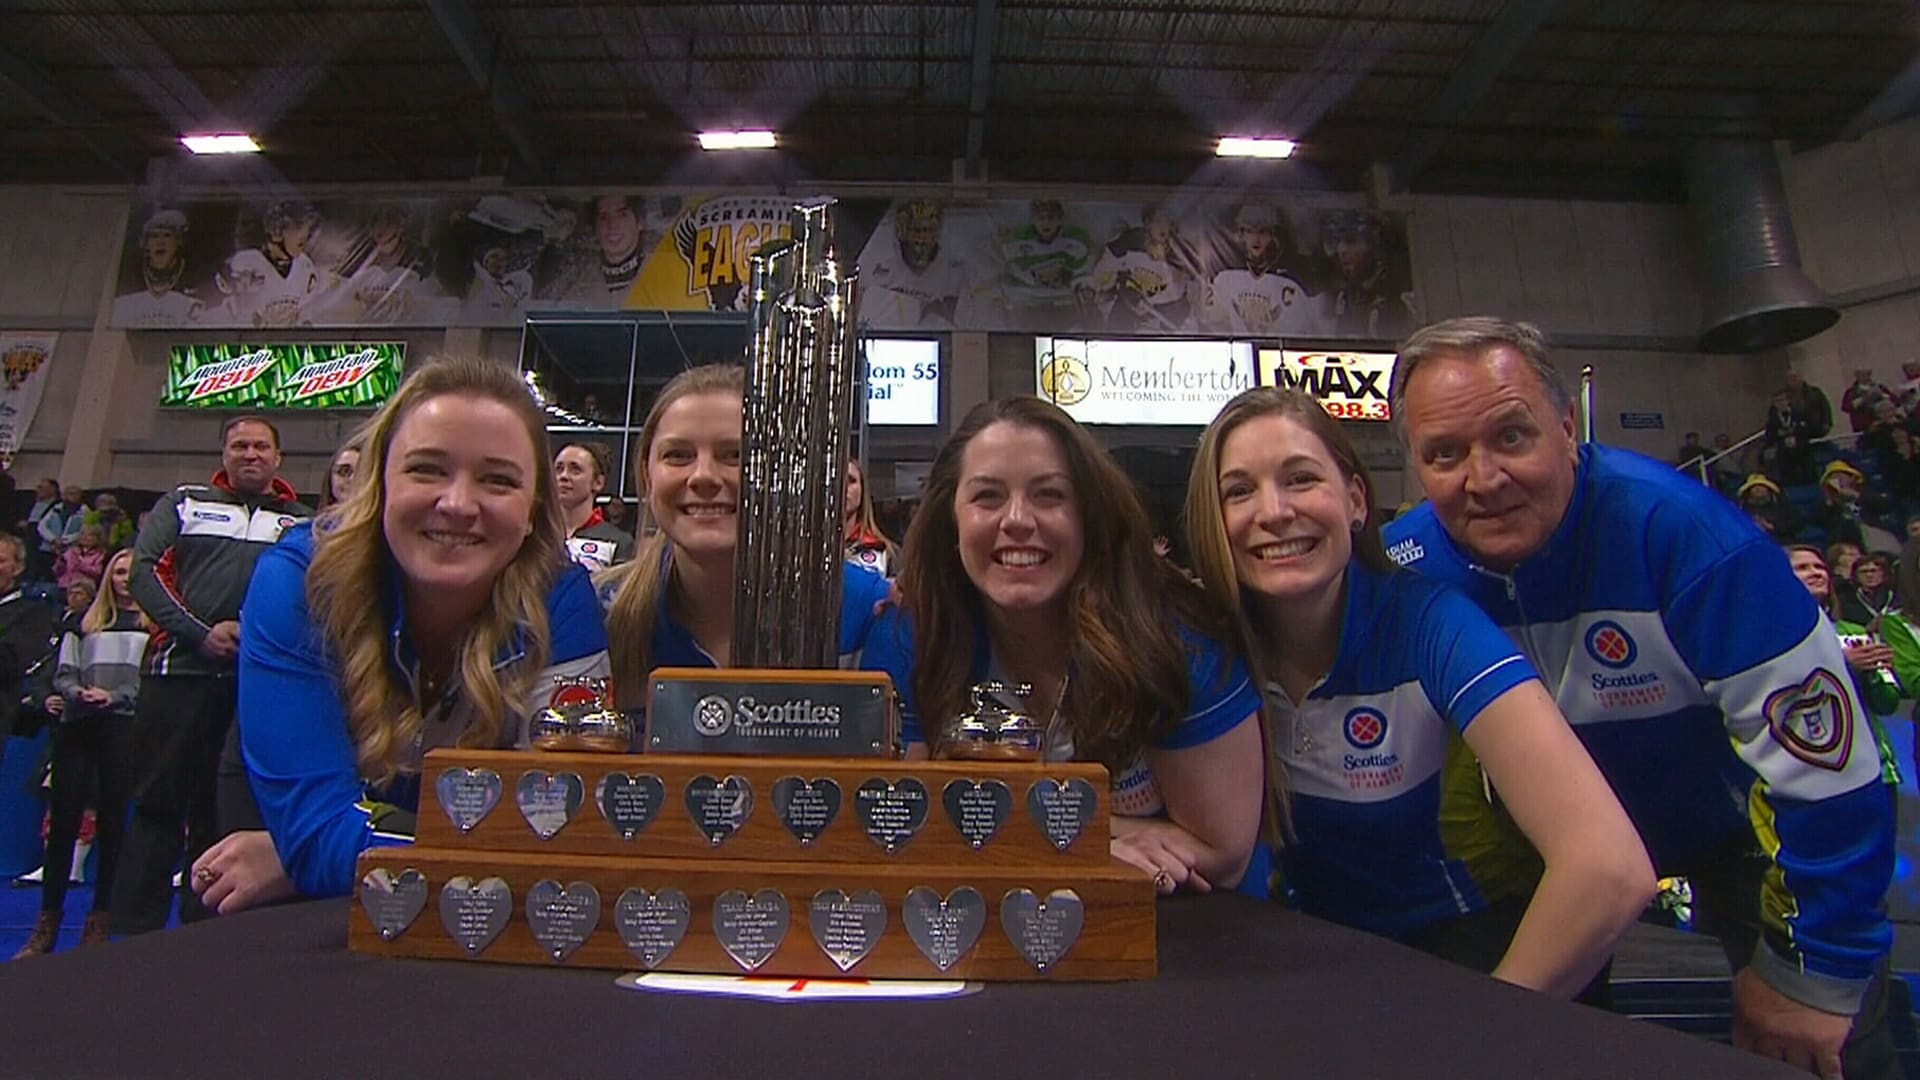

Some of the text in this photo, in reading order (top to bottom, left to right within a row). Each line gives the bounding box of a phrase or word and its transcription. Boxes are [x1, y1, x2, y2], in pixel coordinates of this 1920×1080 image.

[700, 208, 792, 225] SCREAMI
[693, 222, 792, 288] EAG
[912, 362, 937, 380] 55
[1102, 356, 1249, 391] Membertou
[1101, 392, 1176, 402] WELCOMING
[1181, 393, 1201, 402] THE
[1328, 403, 1389, 419] 98.3
[1592, 672, 1658, 690] Scotties
[734, 696, 841, 726] Scotties
[735, 727, 840, 738] TOURNAMENT OF HEARTS
[1344, 753, 1398, 770] Scotties
